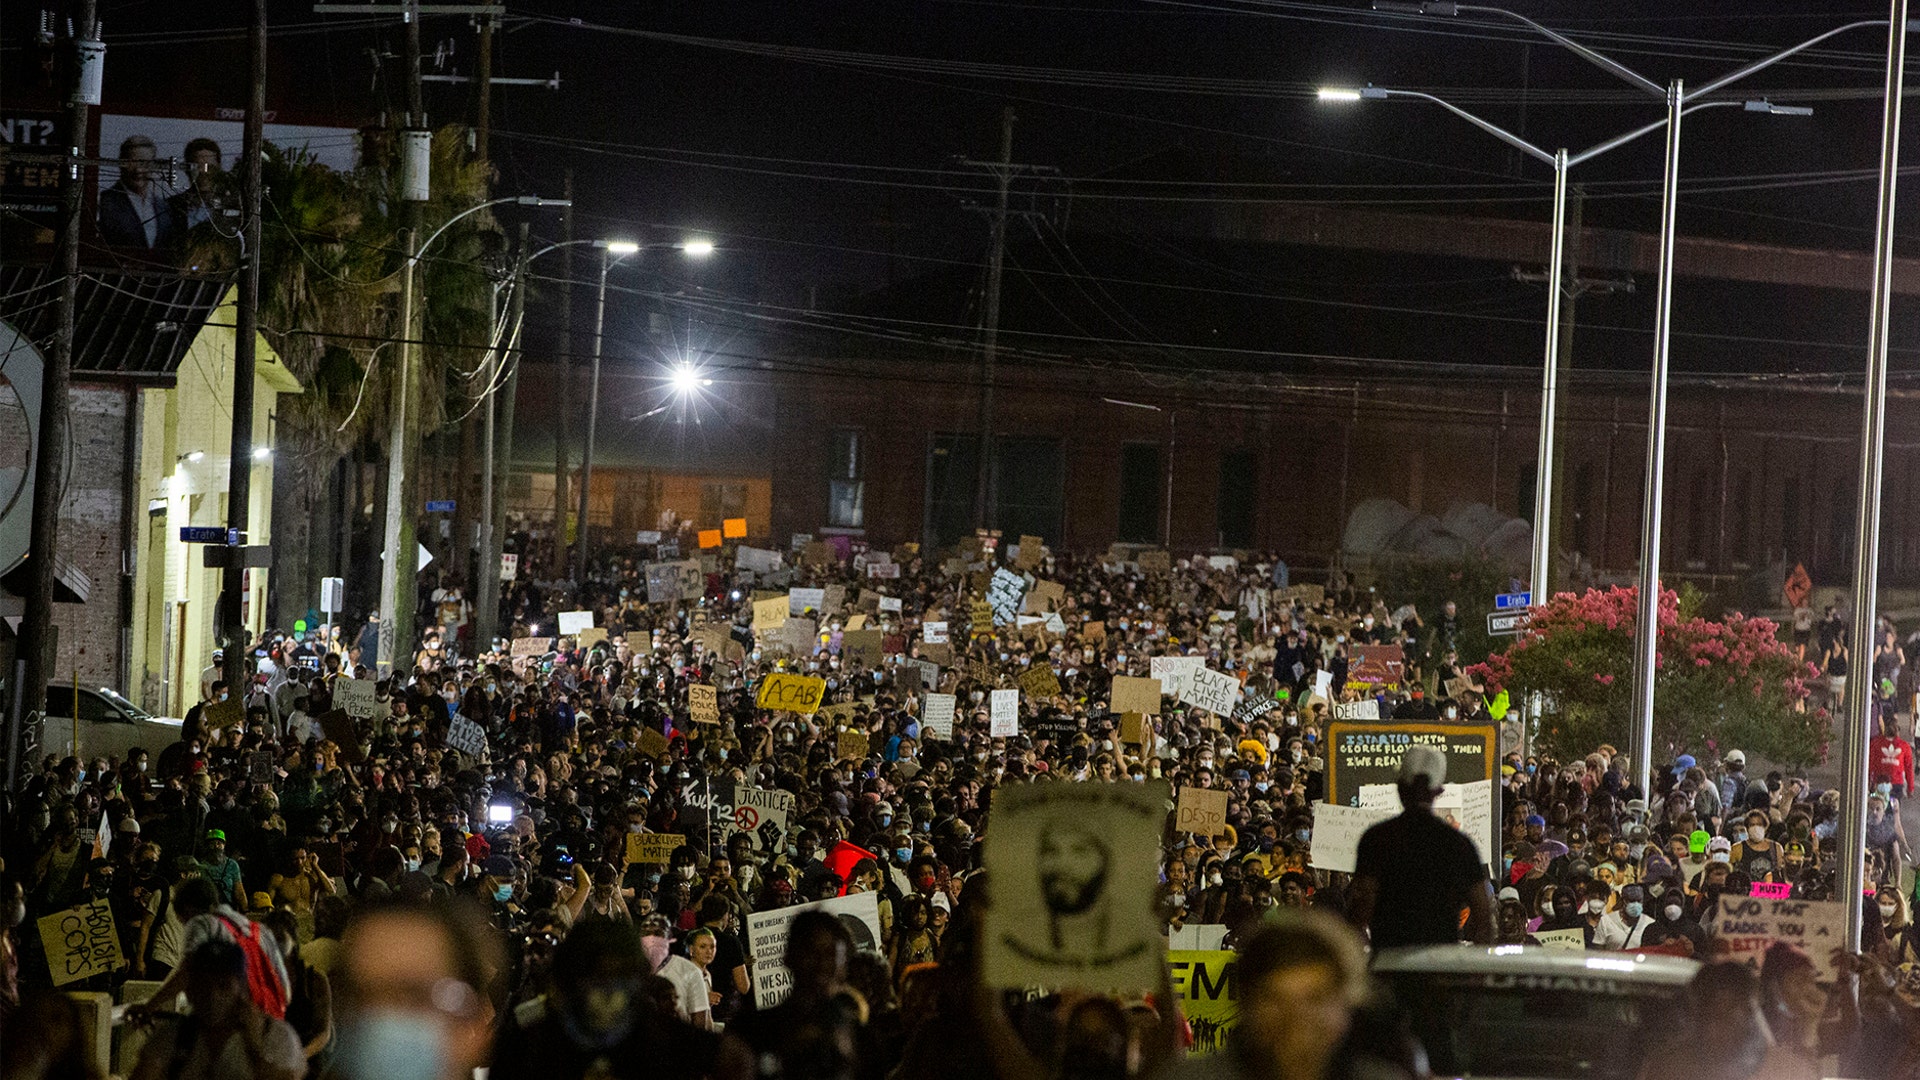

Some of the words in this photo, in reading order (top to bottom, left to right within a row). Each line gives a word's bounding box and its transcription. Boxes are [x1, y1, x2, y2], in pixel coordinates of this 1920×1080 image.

[190, 528, 216, 540] Erato
[1507, 594, 1527, 606] Erato
[761, 606, 786, 620] BLM
[1152, 659, 1175, 673] NO
[1193, 667, 1232, 696] BLACK
[691, 687, 715, 700] STOP
[764, 679, 818, 705] ACAB
[1193, 683, 1228, 703] LIVES
[690, 701, 718, 711] POLICE
[1184, 690, 1229, 714] MATTER
[1252, 699, 1274, 717] PEACE
[1335, 701, 1379, 719] DEFUND
[1346, 735, 1355, 745] I
[1356, 735, 1410, 745] STARTED
[1413, 735, 1446, 743] WITH
[1340, 745, 1382, 753] GEORGE
[1385, 744, 1412, 754] FLOY
[1453, 745, 1482, 754] THEN
[738, 789, 788, 812] JUSTICE
[1181, 807, 1221, 824] DESTO
[634, 834, 662, 846] BLACK
[663, 834, 685, 846] LIVES
[643, 846, 672, 858] MATTE
[1771, 901, 1810, 917] THAT
[753, 921, 765, 930] NEW
[1723, 920, 1768, 934] BADGE
[1777, 922, 1805, 936] YOU
[85, 901, 116, 970] ABOLISH
[755, 936, 769, 947] 300
[1541, 936, 1563, 944] STICE
[1564, 935, 1582, 944] FOR
[61, 915, 92, 975] COPS
[756, 945, 784, 958] RACISM
[759, 974, 775, 990] WE
[775, 971, 794, 988] SAY
[761, 991, 777, 1007] NO
[778, 987, 794, 1005] MO
